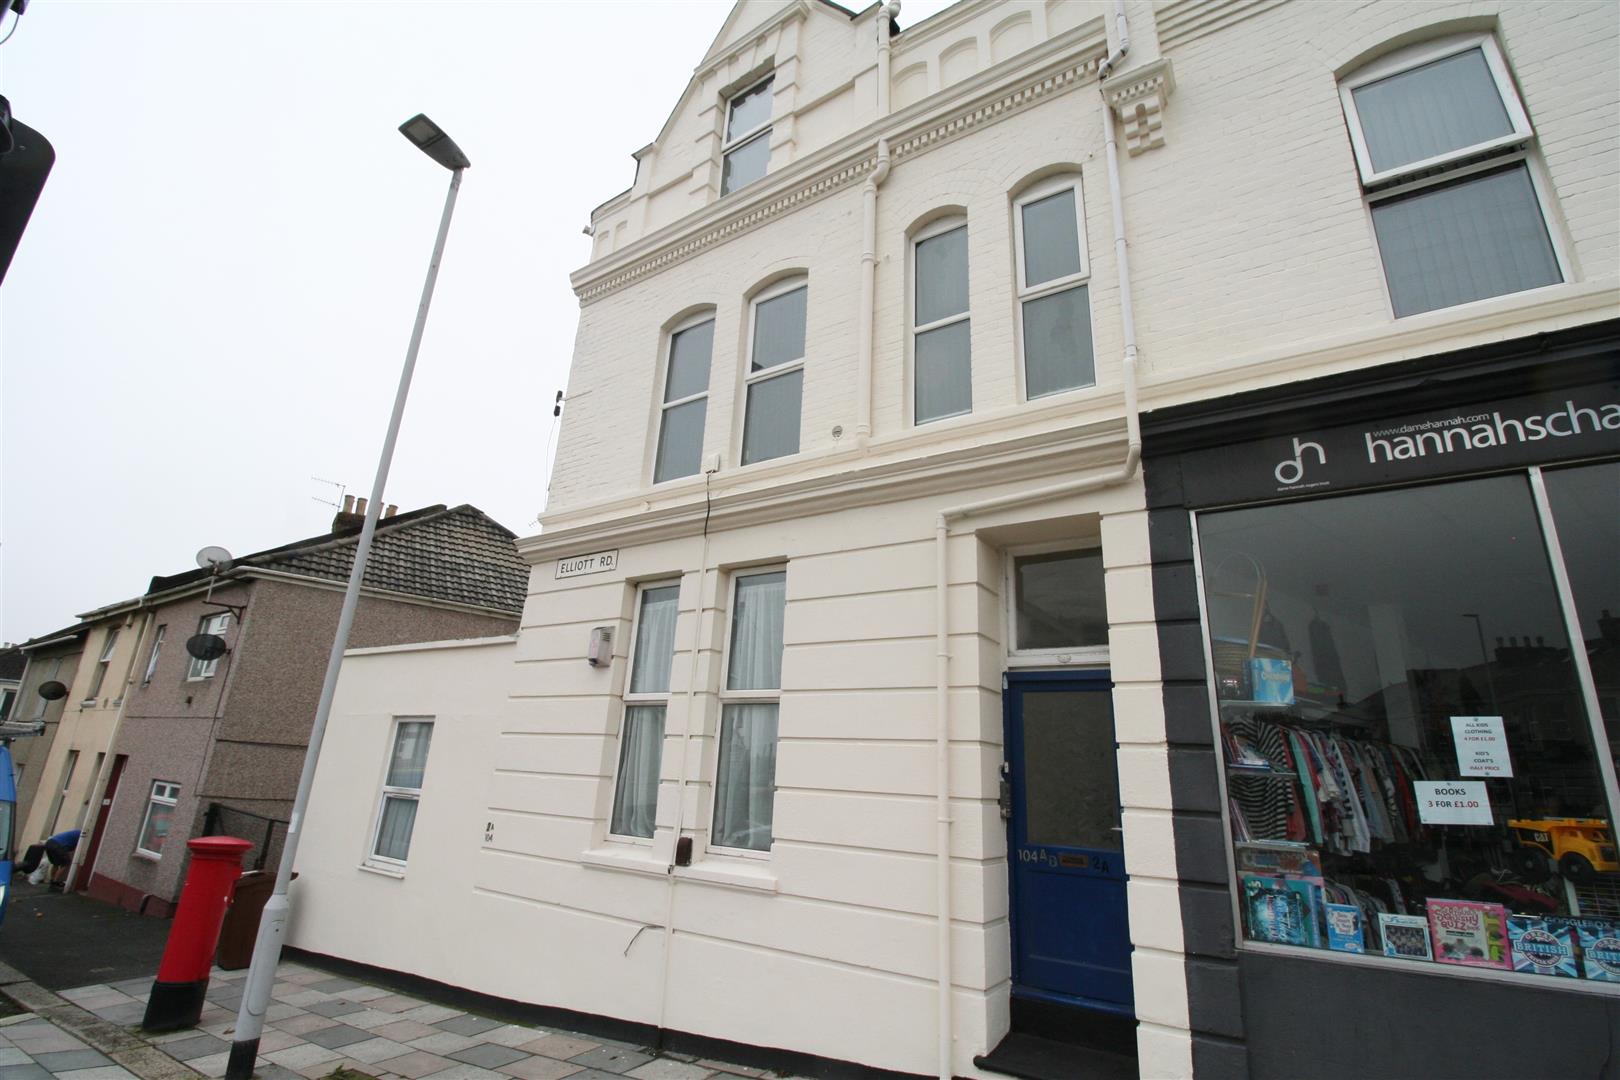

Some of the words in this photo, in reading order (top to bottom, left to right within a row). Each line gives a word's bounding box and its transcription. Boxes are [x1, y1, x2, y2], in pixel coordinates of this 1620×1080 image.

[1372, 413, 1490, 437] www.damehannah.com
[560, 558, 595, 574] ELLIOTT
[1434, 788, 1467, 796] BOOKS
[1428, 800, 1433, 808] 3
[1534, 832, 1549, 842] CAT
[1517, 943, 1568, 955] BRITISH
